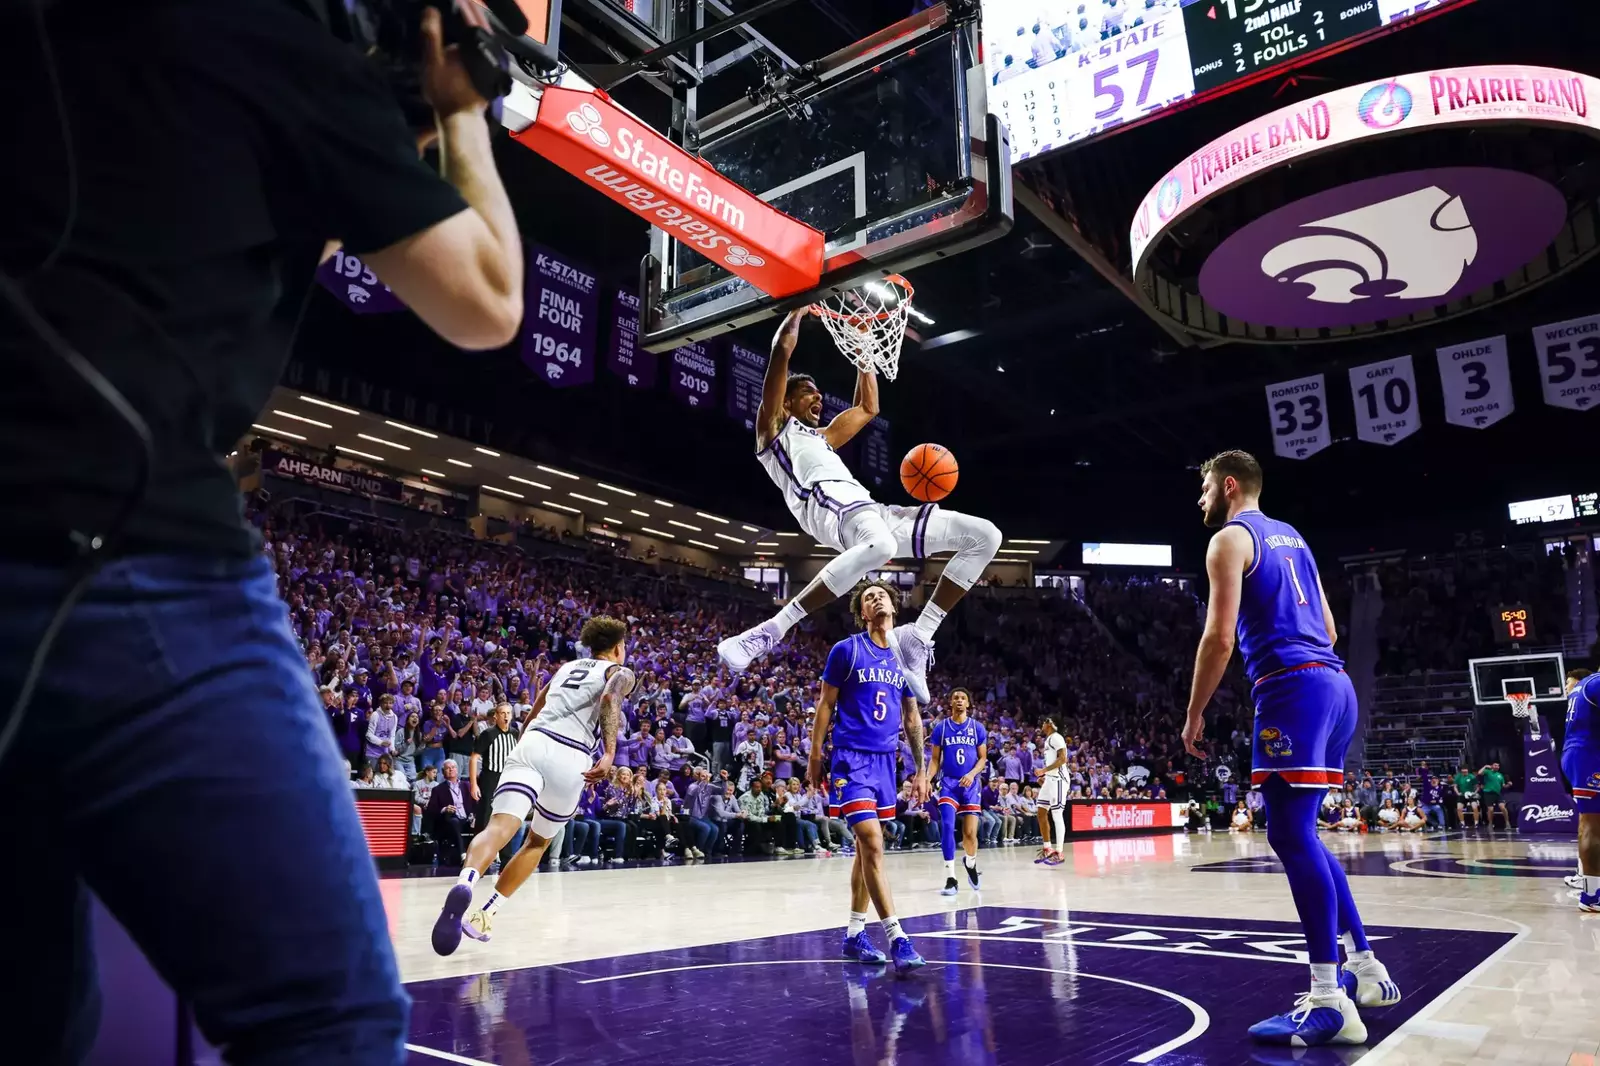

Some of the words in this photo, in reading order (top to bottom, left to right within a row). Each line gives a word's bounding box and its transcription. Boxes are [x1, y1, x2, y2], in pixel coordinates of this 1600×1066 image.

[1244, 11, 1270, 33] 2nd
[1270, 0, 1302, 23] HALF
[1340, 1, 1373, 20] BONUS
[1078, 20, 1165, 68] K-STATE
[1232, 43, 1243, 56] 3
[1260, 23, 1294, 45] TOL
[1313, 10, 1324, 25] 2
[1235, 59, 1246, 73] 2
[1253, 34, 1308, 66] FOULS
[1316, 28, 1326, 41] 1
[1194, 59, 1223, 76] BONUS
[1093, 48, 1160, 120] 57
[1429, 75, 1527, 116] PRAIRIE
[1532, 77, 1587, 118] BAND
[1189, 133, 1262, 195] PRAIRIE
[1267, 99, 1330, 149] BAND
[333, 250, 391, 292] 195
[536, 253, 595, 289] K-STATE
[539, 303, 581, 334] FOUR
[541, 287, 584, 319] FINAL
[1545, 323, 1598, 340] WECKER
[533, 333, 582, 368] 1964
[674, 353, 716, 377] CHAMPIONS
[1452, 345, 1493, 361] OHLDE
[1547, 336, 1600, 384] 53
[680, 371, 710, 394] 2019
[1366, 365, 1395, 379] GARY
[1461, 361, 1491, 400] 3
[1271, 382, 1319, 399] ROMSTAD
[1358, 377, 1411, 419] 10
[1274, 395, 1323, 436] 33
[1547, 504, 1564, 516] 57
[1284, 556, 1309, 606] 1
[1501, 609, 1527, 622] 15:40
[1509, 620, 1526, 638] 13
[560, 669, 589, 690] 2
[857, 667, 905, 690] KANSAS
[873, 690, 887, 721] 5
[945, 735, 976, 747] KANSAS
[956, 748, 966, 765] 6
[1521, 804, 1574, 823] Dillons
